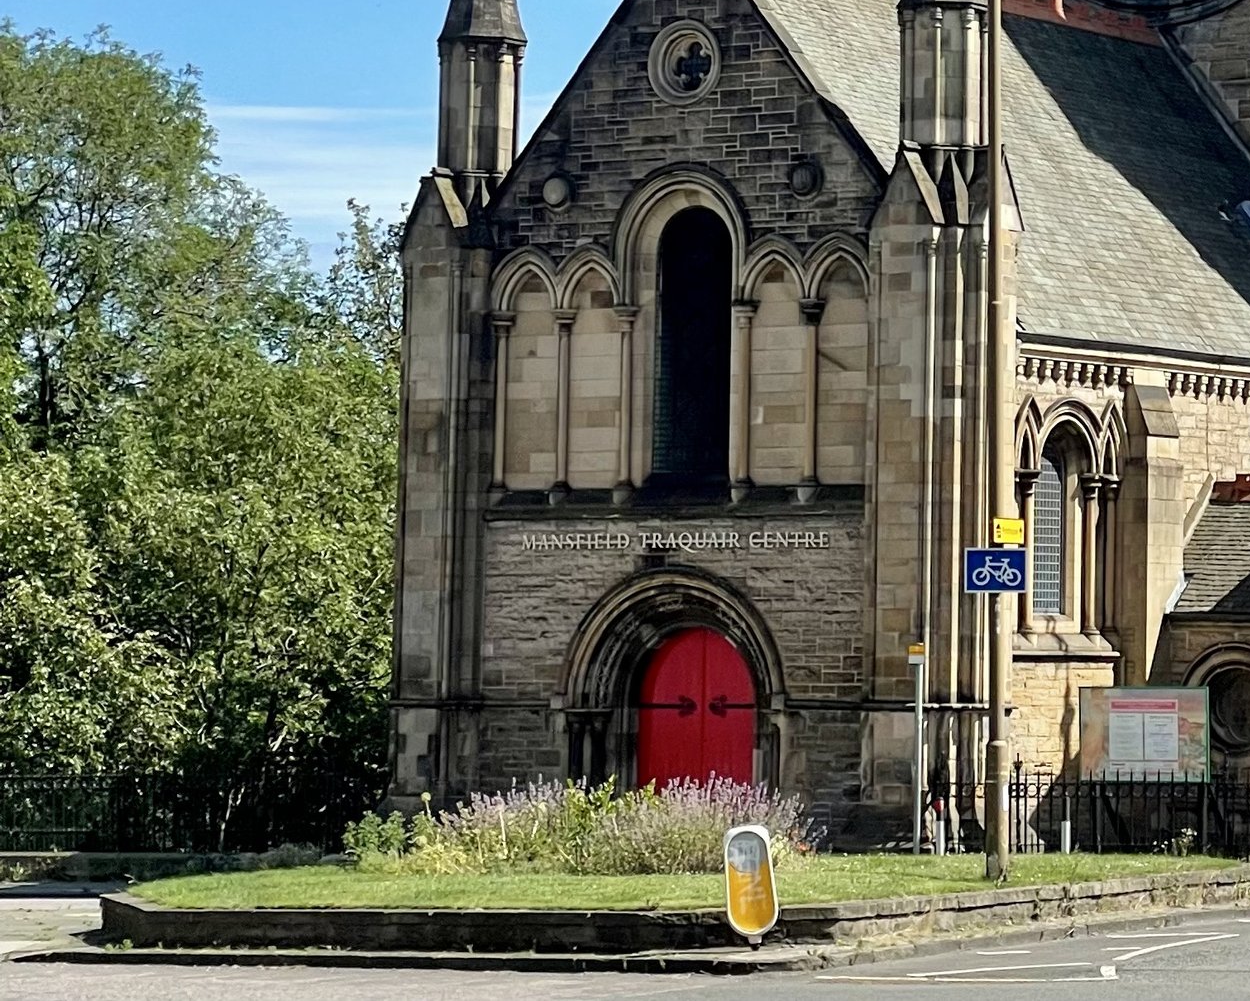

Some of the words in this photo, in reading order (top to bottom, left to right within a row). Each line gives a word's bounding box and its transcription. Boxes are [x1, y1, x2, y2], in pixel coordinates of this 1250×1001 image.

[522, 532, 631, 549] MANSFIELD
[638, 532, 741, 553] TRAQUAIR
[749, 531, 829, 547] CENTRE
